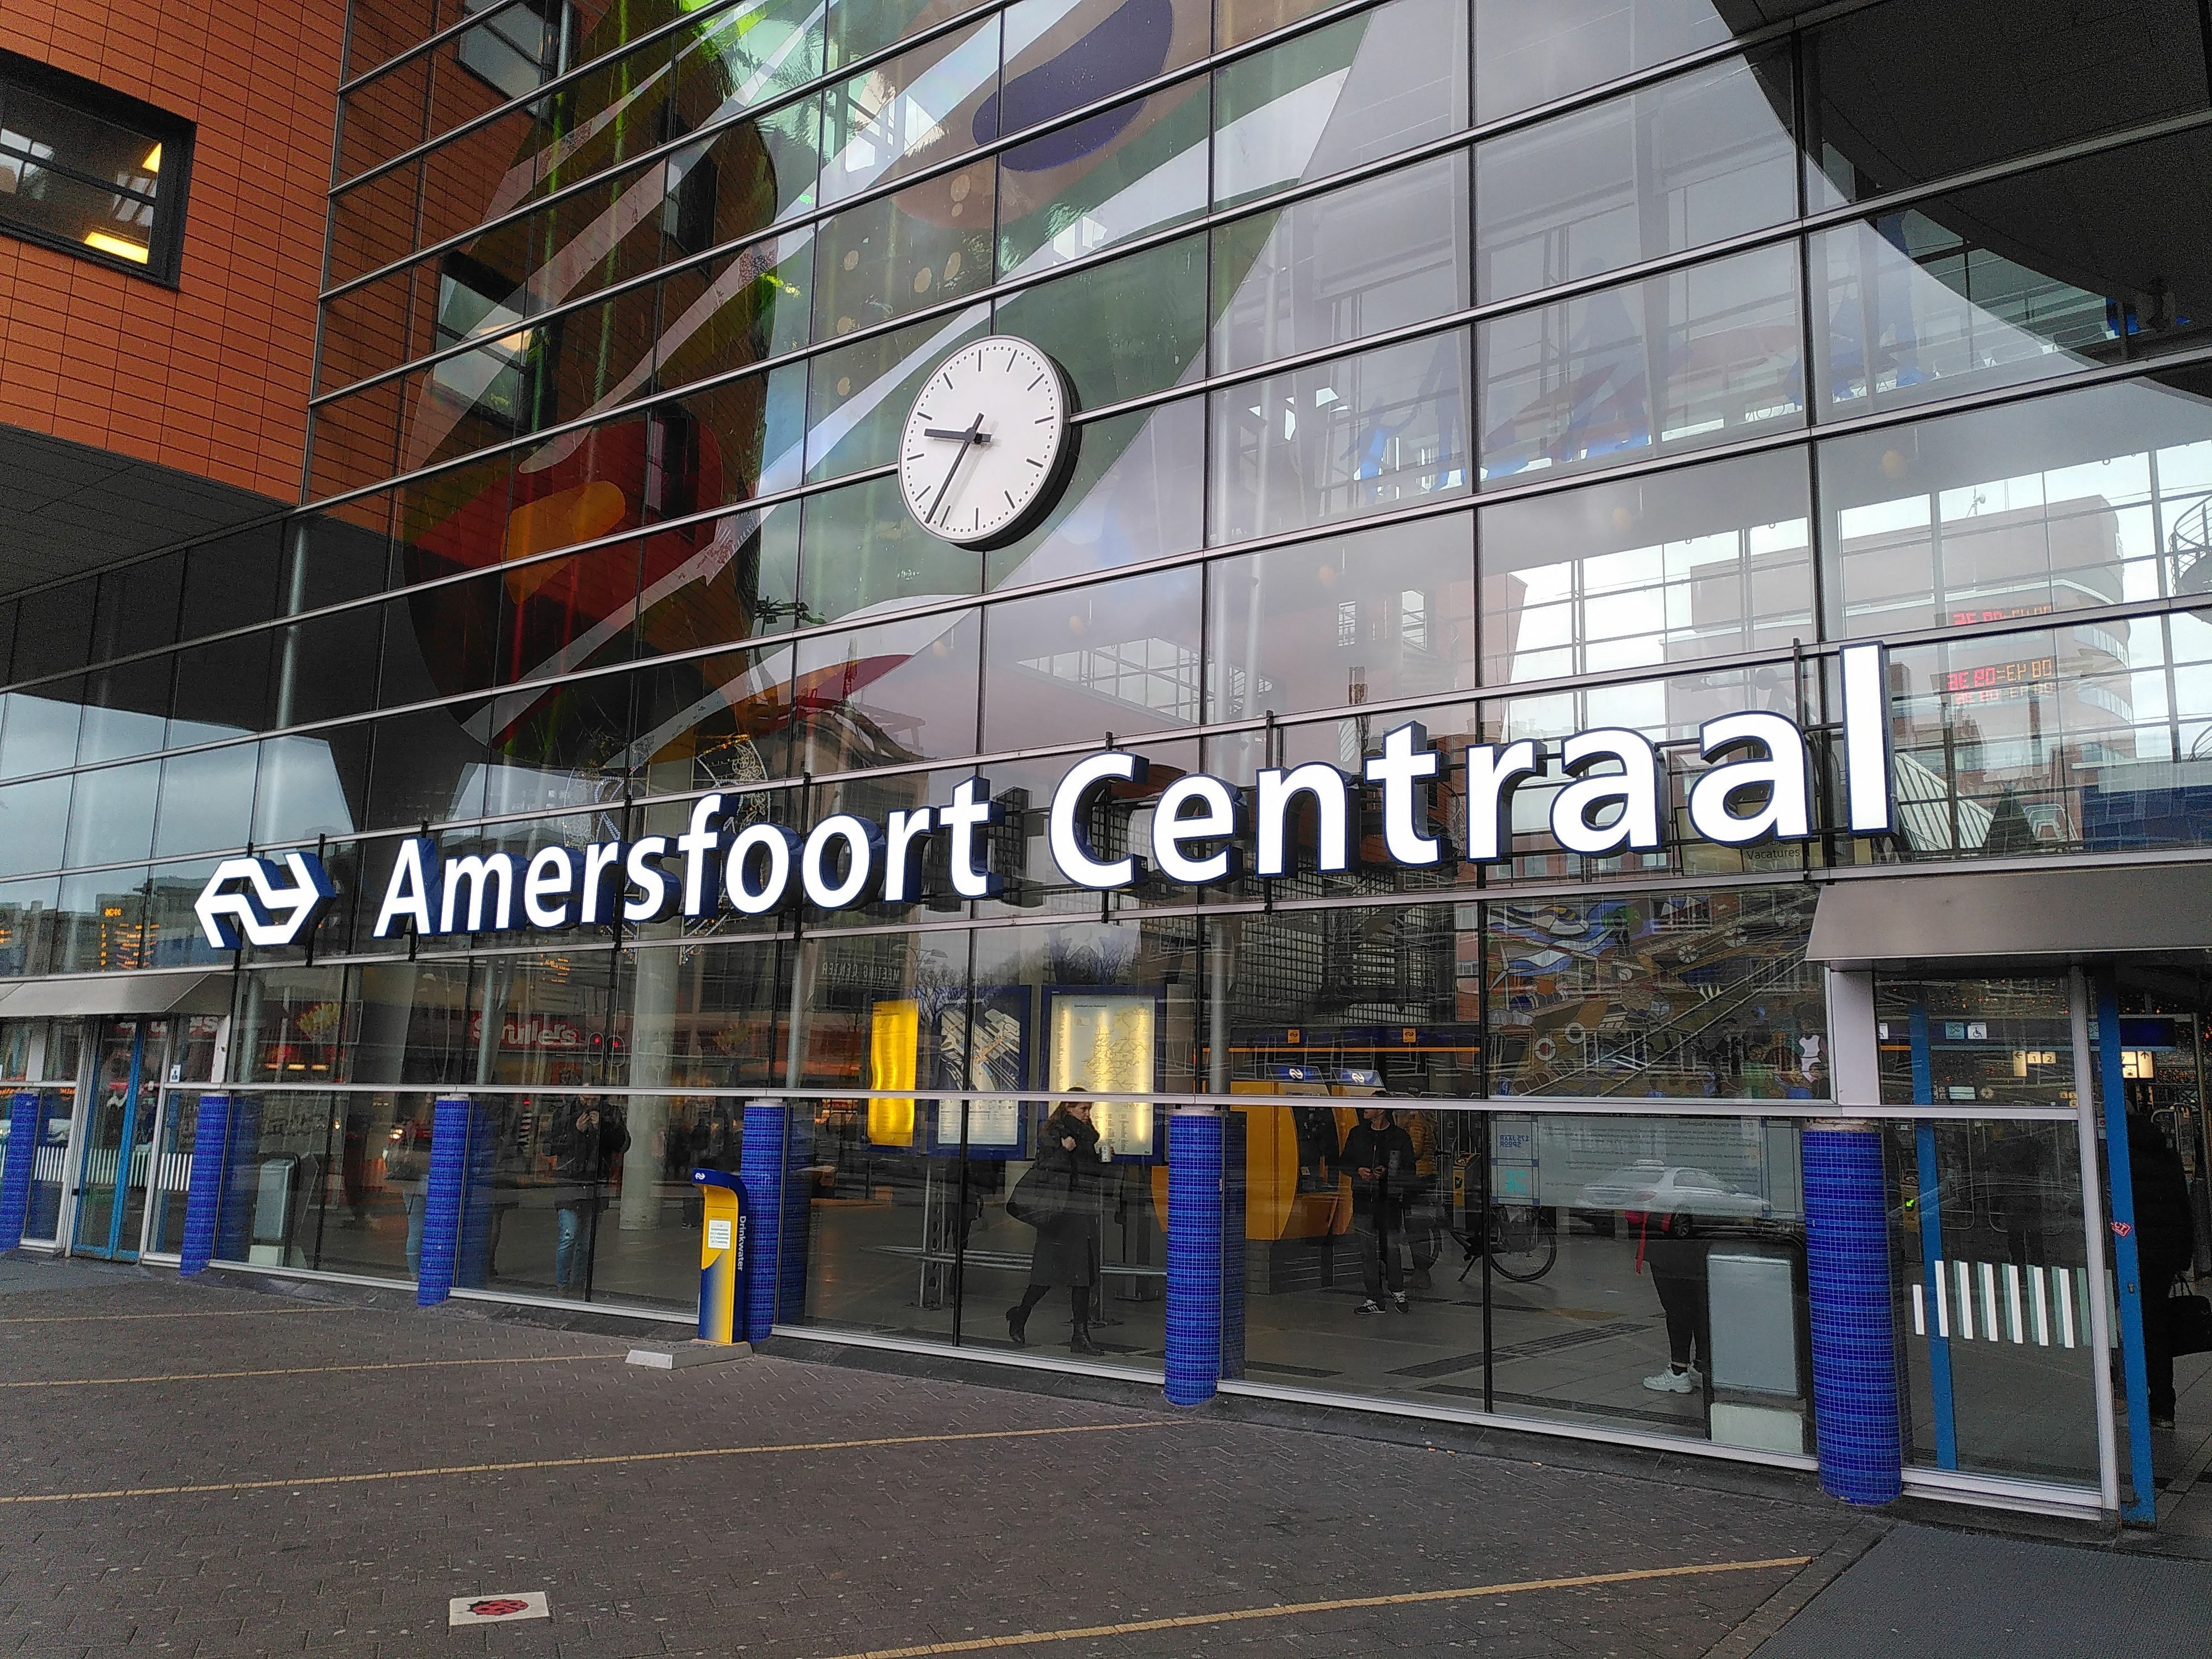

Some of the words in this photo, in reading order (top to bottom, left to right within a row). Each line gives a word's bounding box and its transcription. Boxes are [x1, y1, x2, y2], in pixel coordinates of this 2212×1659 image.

[373, 779, 989, 937] Amersfoort
[1050, 644, 1888, 888] Centraal
[1746, 848, 1801, 860] Vacatures
[737, 1215, 747, 1272] Drinkwater
